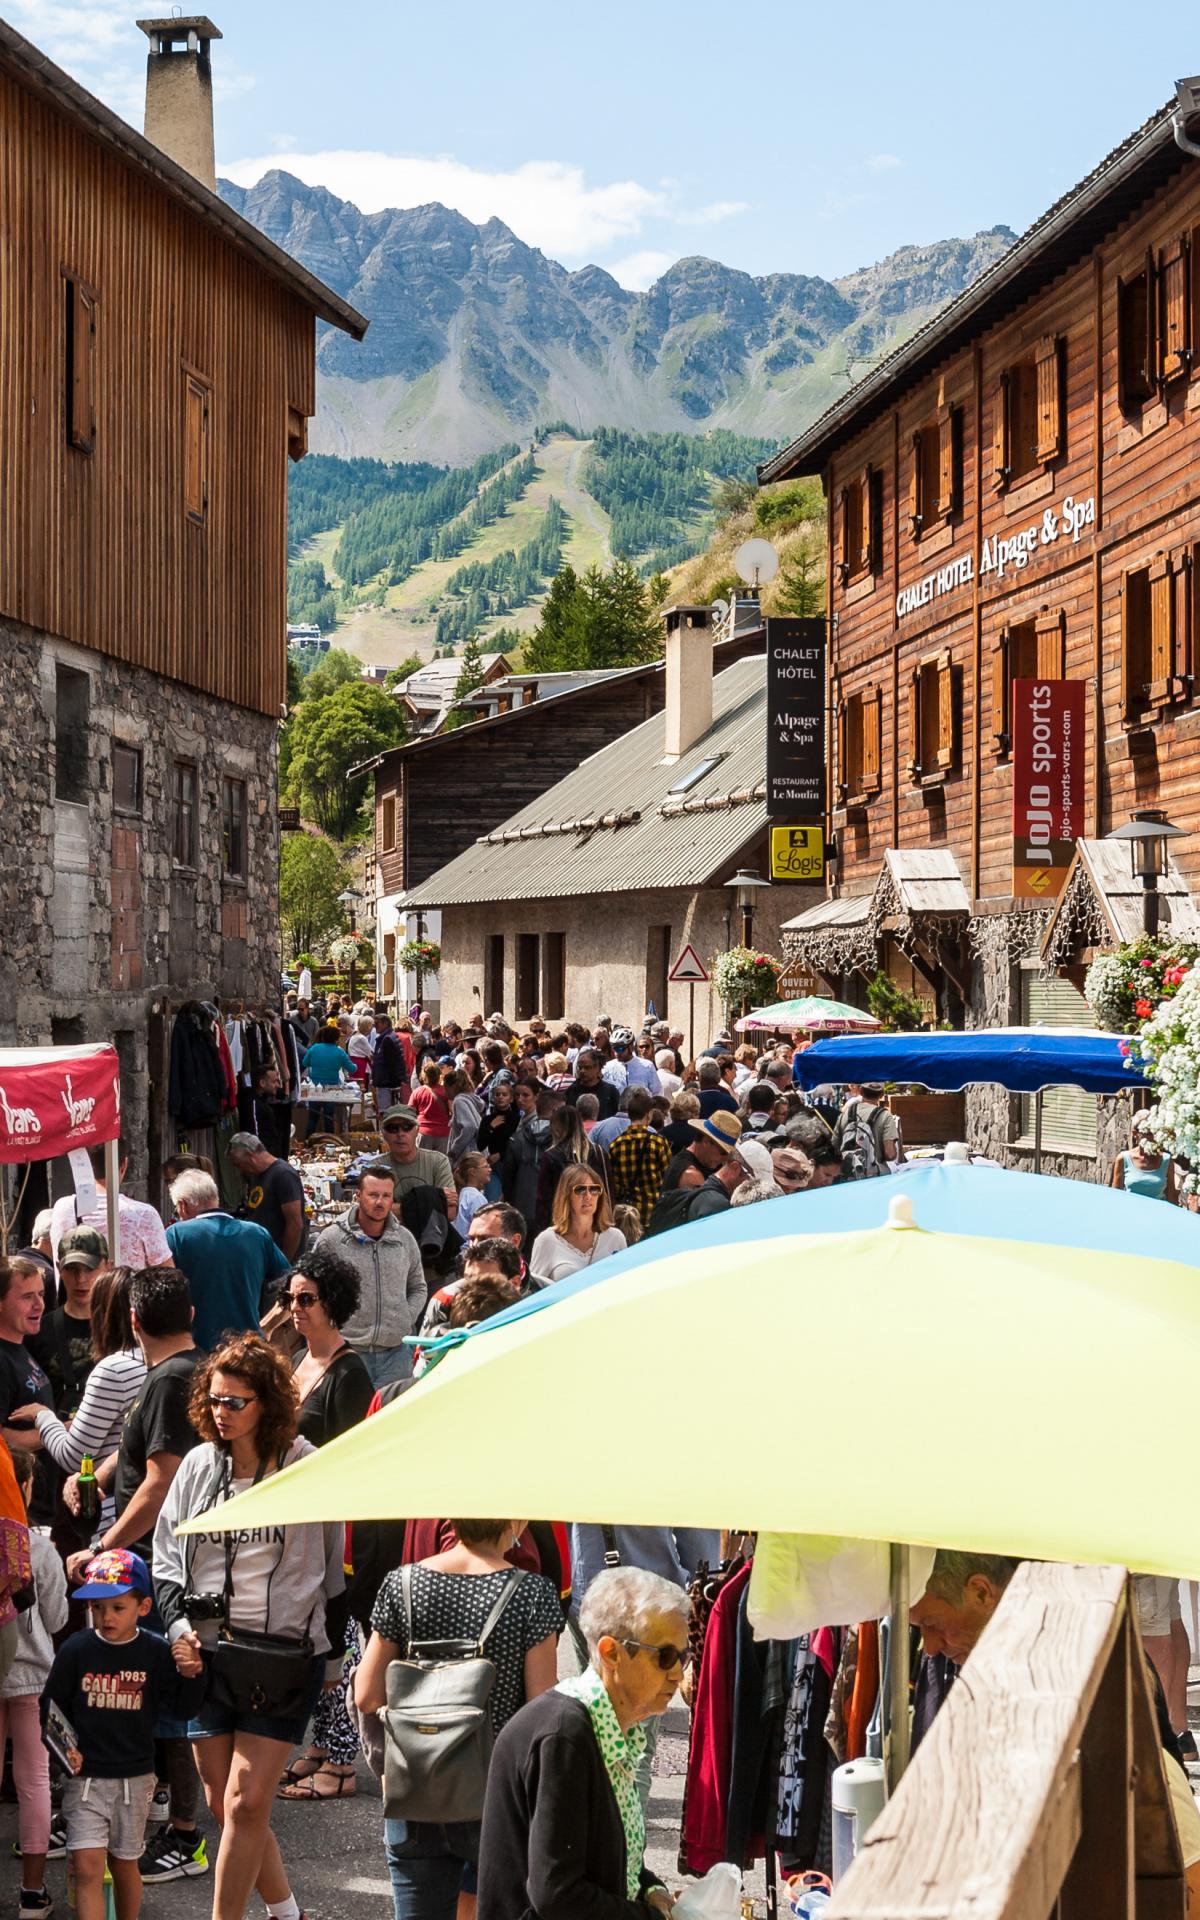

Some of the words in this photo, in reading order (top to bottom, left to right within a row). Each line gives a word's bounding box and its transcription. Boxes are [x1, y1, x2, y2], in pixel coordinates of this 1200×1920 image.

[896, 573, 936, 617] CHALET
[937, 554, 975, 597] HOTEL
[979, 526, 1037, 577] Alpage
[1040, 508, 1059, 545] &
[1062, 496, 1095, 543] Spa
[773, 648, 820, 660] CHALET
[777, 666, 816, 679] HÔTEL
[774, 713, 819, 732] Alpage
[1028, 684, 1057, 773] sports
[779, 731, 790, 743] &
[793, 731, 814, 744] Spa
[772, 778, 820, 786] RESTAURANT
[772, 789, 786, 799] Le
[786, 789, 820, 800] Moulin
[775, 848, 823, 876] Logis
[781, 977, 815, 988] OUVERT
[784, 989, 807, 999] OPEN
[61, 1074, 96, 1127] Vars
[0, 1086, 41, 1134] Vars
[120, 1670, 147, 1682] 1983
[81, 1675, 119, 1693] CALI
[87, 1692, 143, 1710] FORNIA
